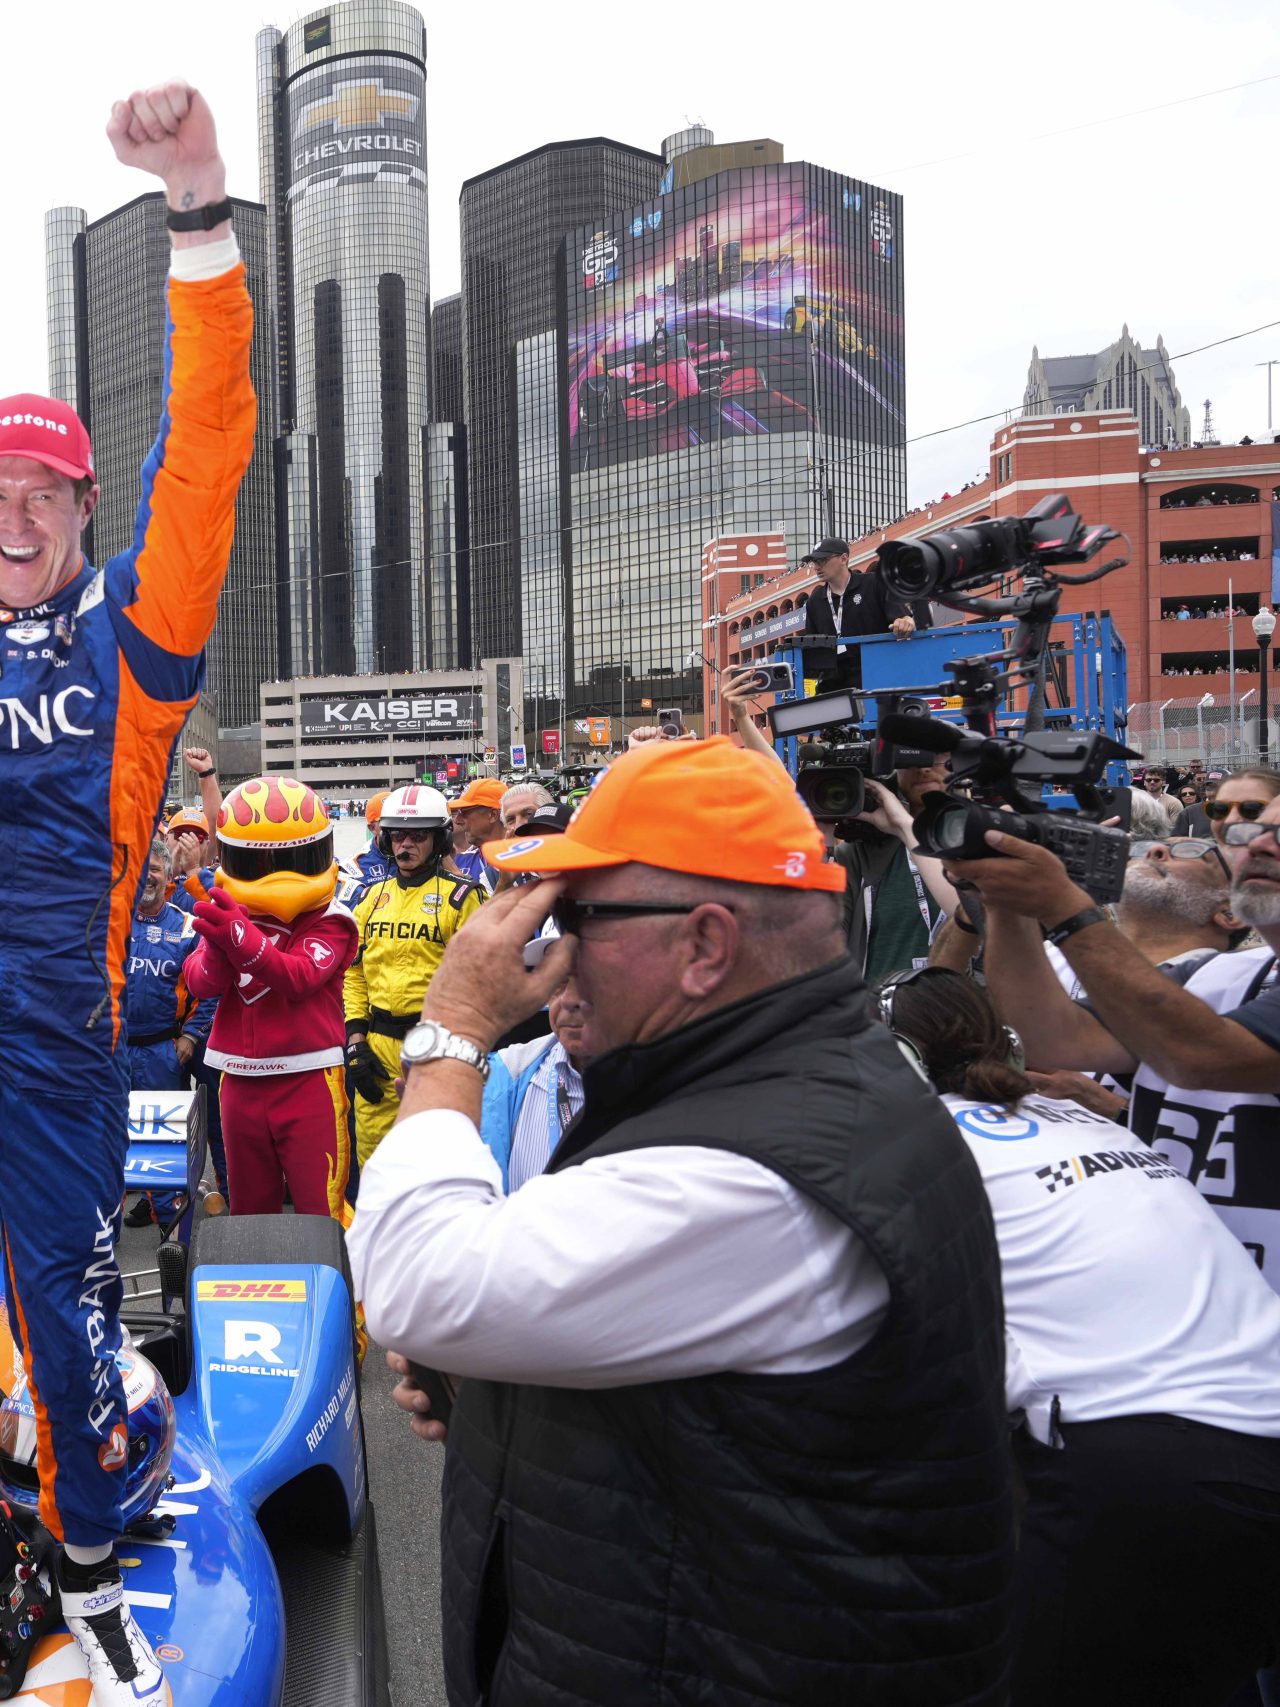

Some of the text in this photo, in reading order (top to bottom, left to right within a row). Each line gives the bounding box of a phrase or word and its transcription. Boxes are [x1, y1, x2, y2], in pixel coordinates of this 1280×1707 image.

[295, 135, 422, 170] CHEVROLET
[583, 238, 618, 256] DETROIT
[324, 699, 458, 722] KAISER
[597, 732, 602, 740] 9
[437, 772, 446, 780] 27
[245, 836, 317, 849] FIREHAWK
[495, 838, 545, 861] 9
[131, 957, 176, 977] PNC
[226, 1062, 285, 1071] FIREHAWK
[79, 1202, 121, 1357] BANK
[212, 1284, 292, 1298] DHL
[209, 1363, 300, 1377] RIDGELINE
[305, 1366, 354, 1454] RICHARD MILLE
